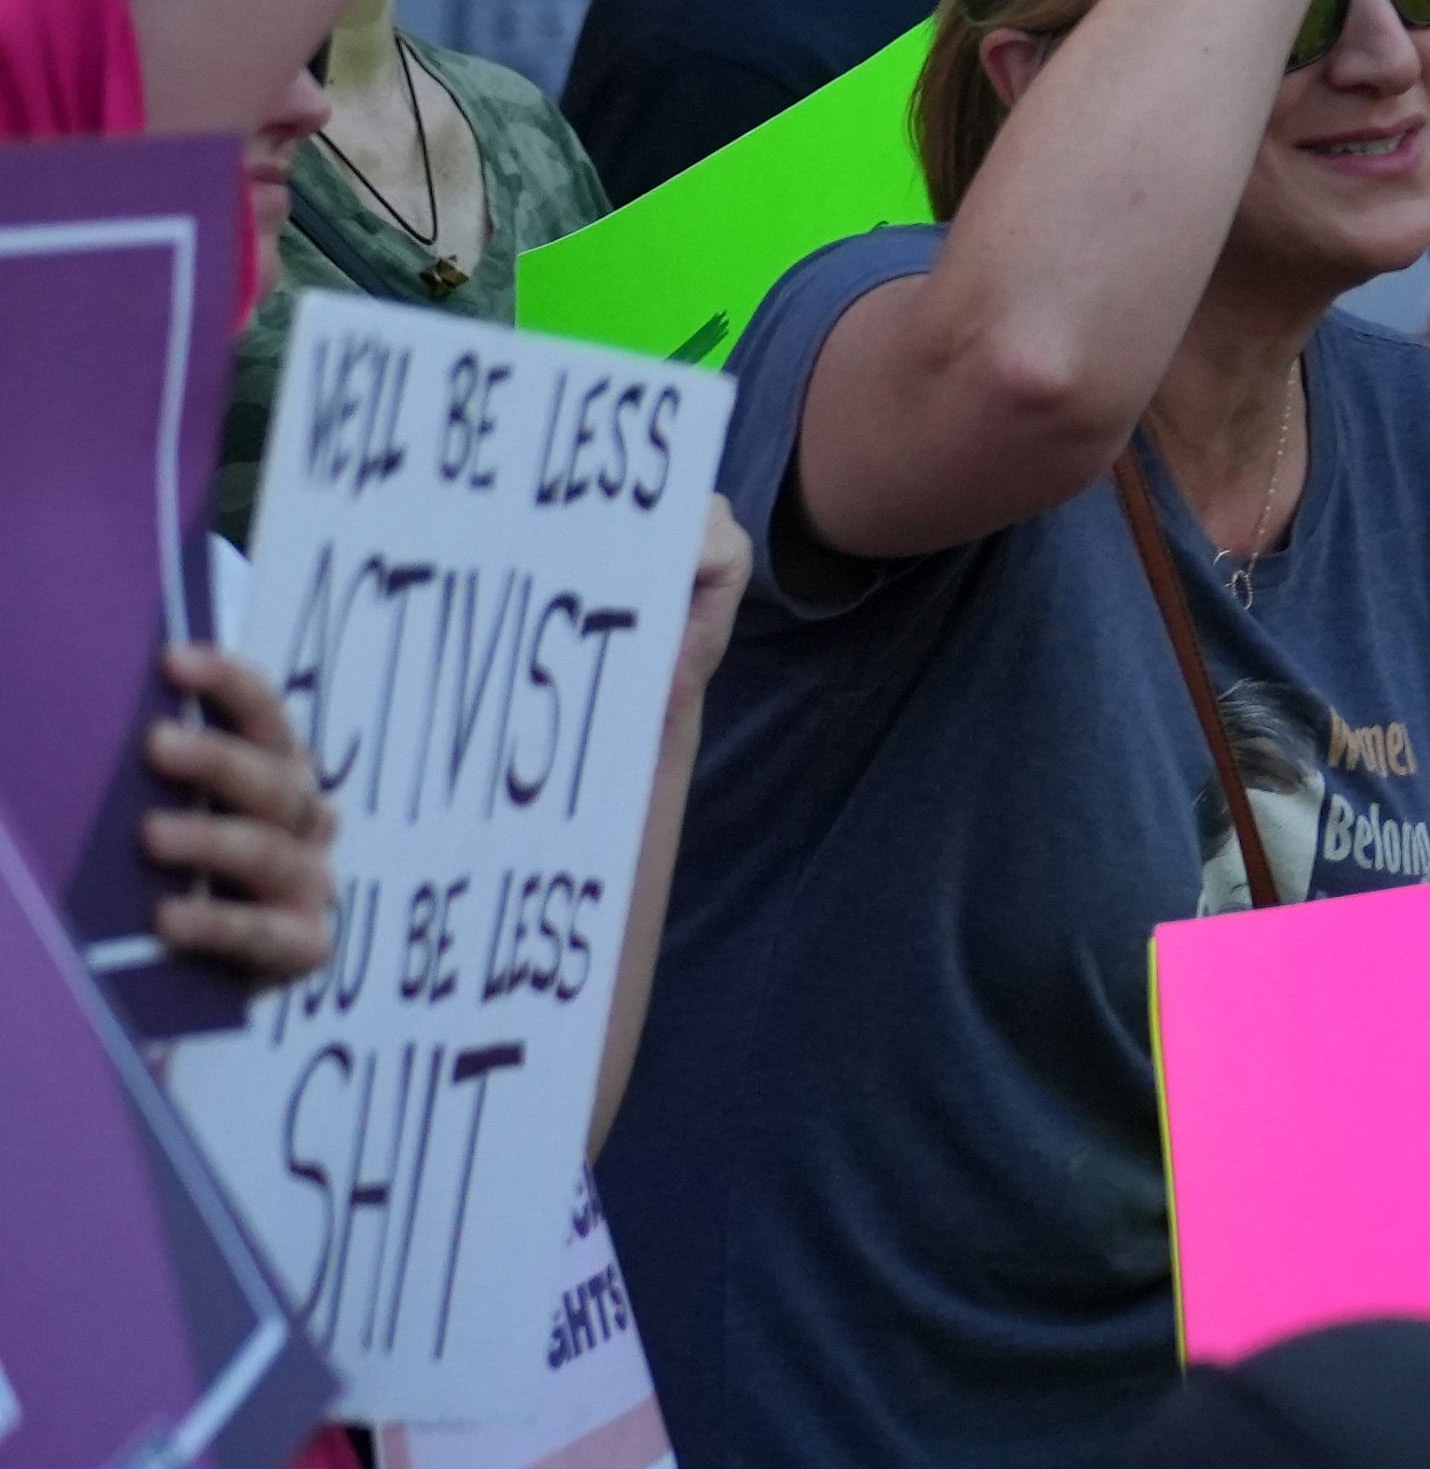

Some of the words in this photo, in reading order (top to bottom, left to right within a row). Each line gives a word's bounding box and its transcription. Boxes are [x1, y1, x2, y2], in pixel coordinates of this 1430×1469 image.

[437, 349, 512, 490] BE
[534, 368, 682, 511] LESS
[283, 539, 637, 824] ACTIVIST
[399, 873, 471, 1005] BE
[481, 869, 602, 1005] LESS
[282, 1041, 526, 1362] SHIT
